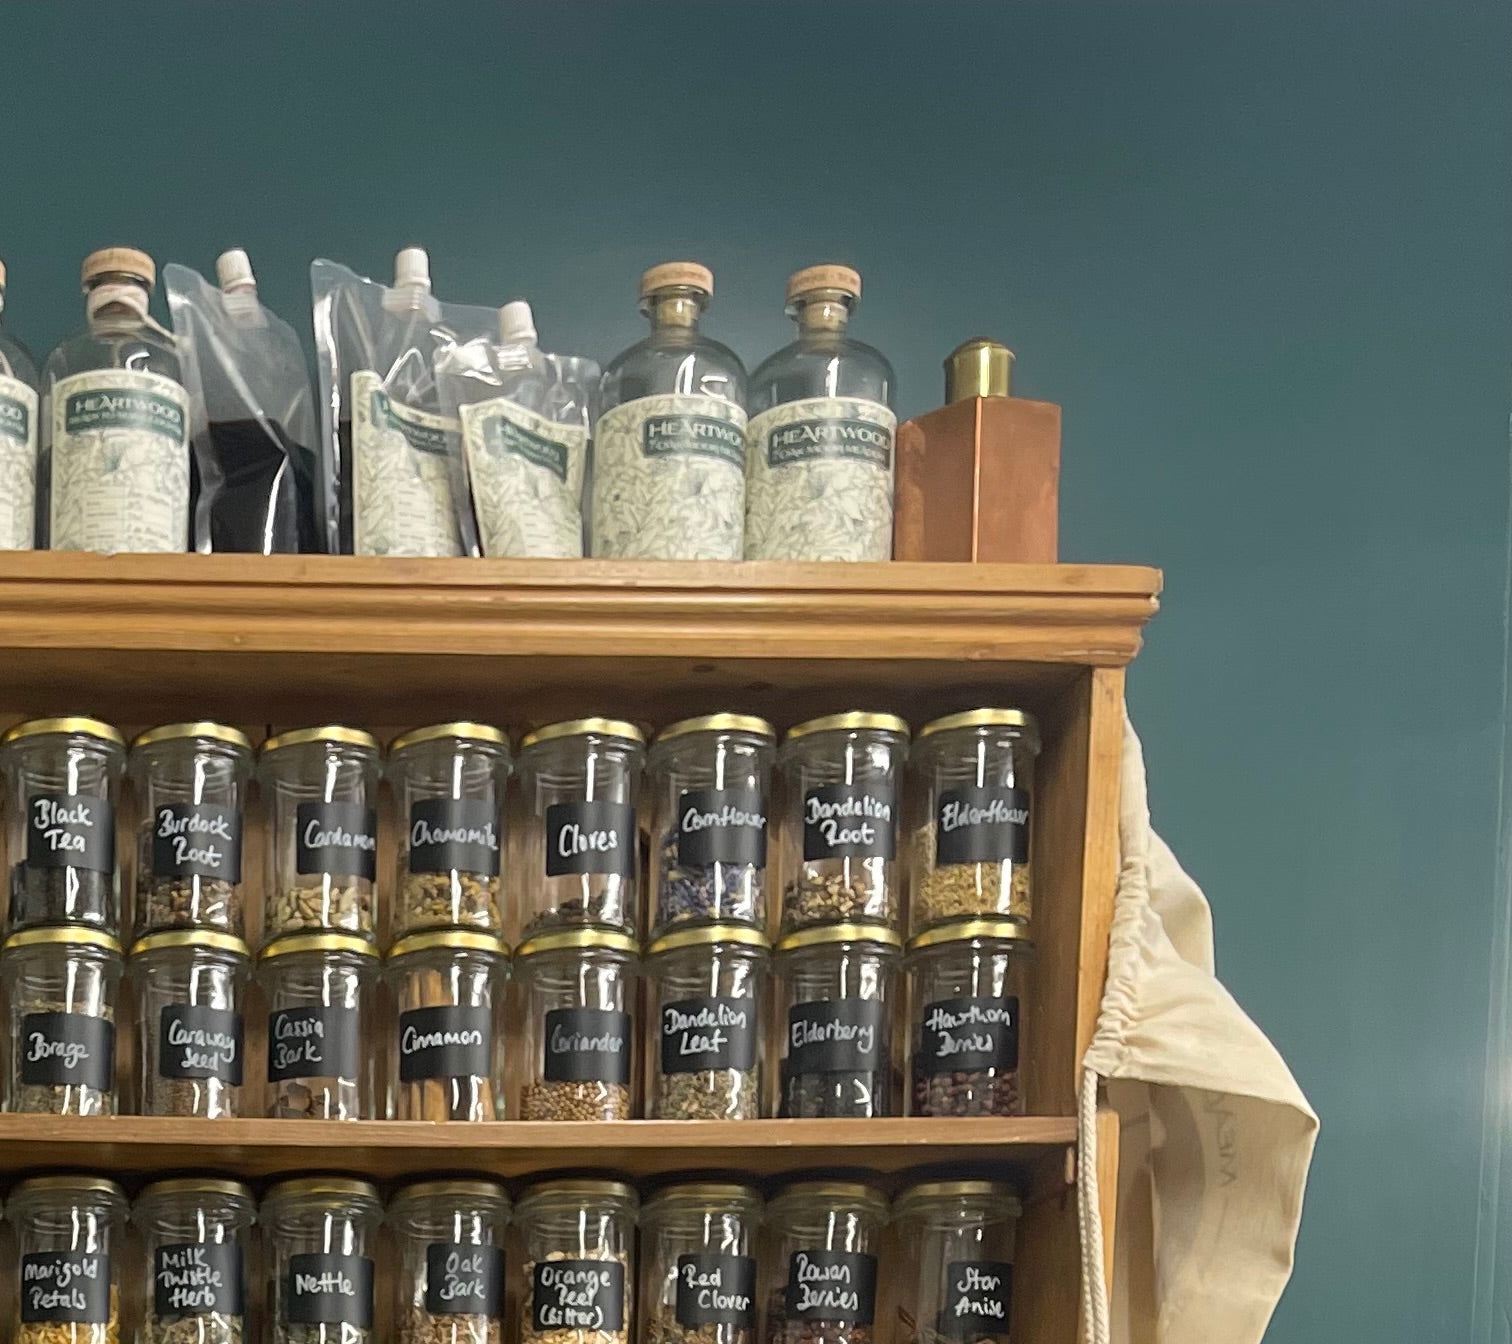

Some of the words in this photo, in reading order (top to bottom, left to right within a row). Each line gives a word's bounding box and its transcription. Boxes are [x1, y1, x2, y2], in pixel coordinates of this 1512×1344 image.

[76, 394, 181, 424] HEARTWOOD
[33, 801, 94, 828] Black
[682, 807, 767, 832] Cornflower
[805, 796, 892, 822] Dandelion
[941, 800, 1030, 832] Elderflower
[159, 809, 233, 841] Burdock
[411, 819, 499, 851] Chamomile
[819, 824, 876, 848] Root
[44, 827, 87, 853] Tea
[558, 823, 618, 858] Cloves
[174, 840, 223, 867] Root
[274, 1014, 324, 1040] Cassia
[663, 1006, 747, 1034] Dandelion
[926, 1006, 1012, 1030] Hawthorn
[167, 1019, 236, 1063] Caraway
[401, 1027, 483, 1056] Cinnamon
[551, 1024, 624, 1055] Coriander
[679, 1031, 728, 1057] Leaf
[791, 1018, 875, 1054] Elderberry
[936, 1030, 994, 1057] Berries
[26, 1032, 91, 1068] Borage
[273, 1044, 323, 1070] Bark
[162, 1249, 209, 1269] Milk
[445, 1251, 483, 1276] Oak
[796, 1253, 851, 1283] Rowan
[157, 1266, 223, 1290] Thistle
[294, 1270, 356, 1298] Nettle
[439, 1276, 486, 1301] Bark
[540, 1266, 611, 1291] Orange
[683, 1264, 722, 1289] Red
[958, 1270, 1001, 1293] Star
[31, 1285, 88, 1311] Petals
[168, 1287, 216, 1310] Herb
[557, 1286, 596, 1308] Peel
[698, 1288, 751, 1311] Clover
[797, 1281, 859, 1312] Berries
[954, 1295, 1005, 1319] Anise
